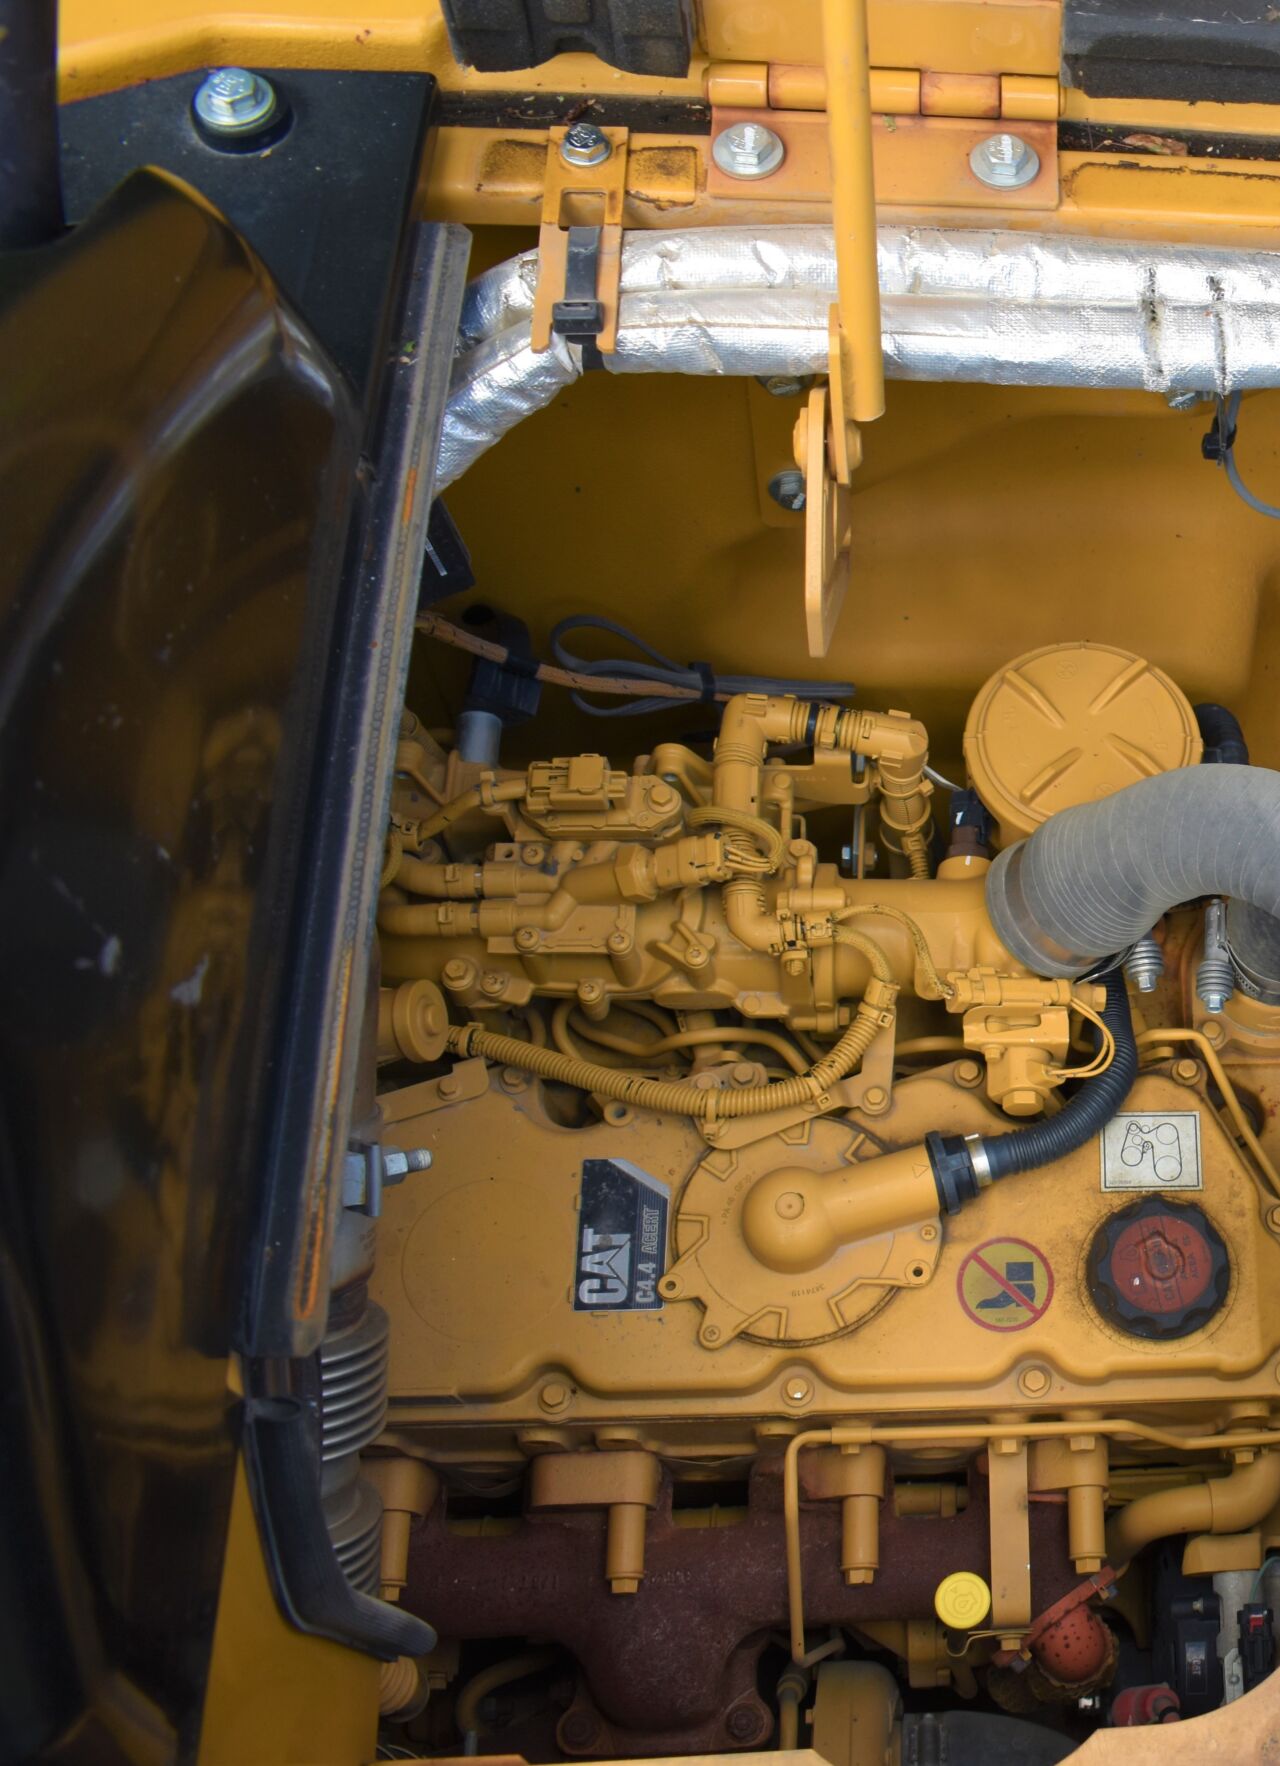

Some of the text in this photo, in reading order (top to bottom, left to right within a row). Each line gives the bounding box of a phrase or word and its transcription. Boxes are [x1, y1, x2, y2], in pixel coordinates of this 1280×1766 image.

[579, 1228, 631, 1304] CAT
[635, 1207, 660, 1304] C4.4 ACERT
